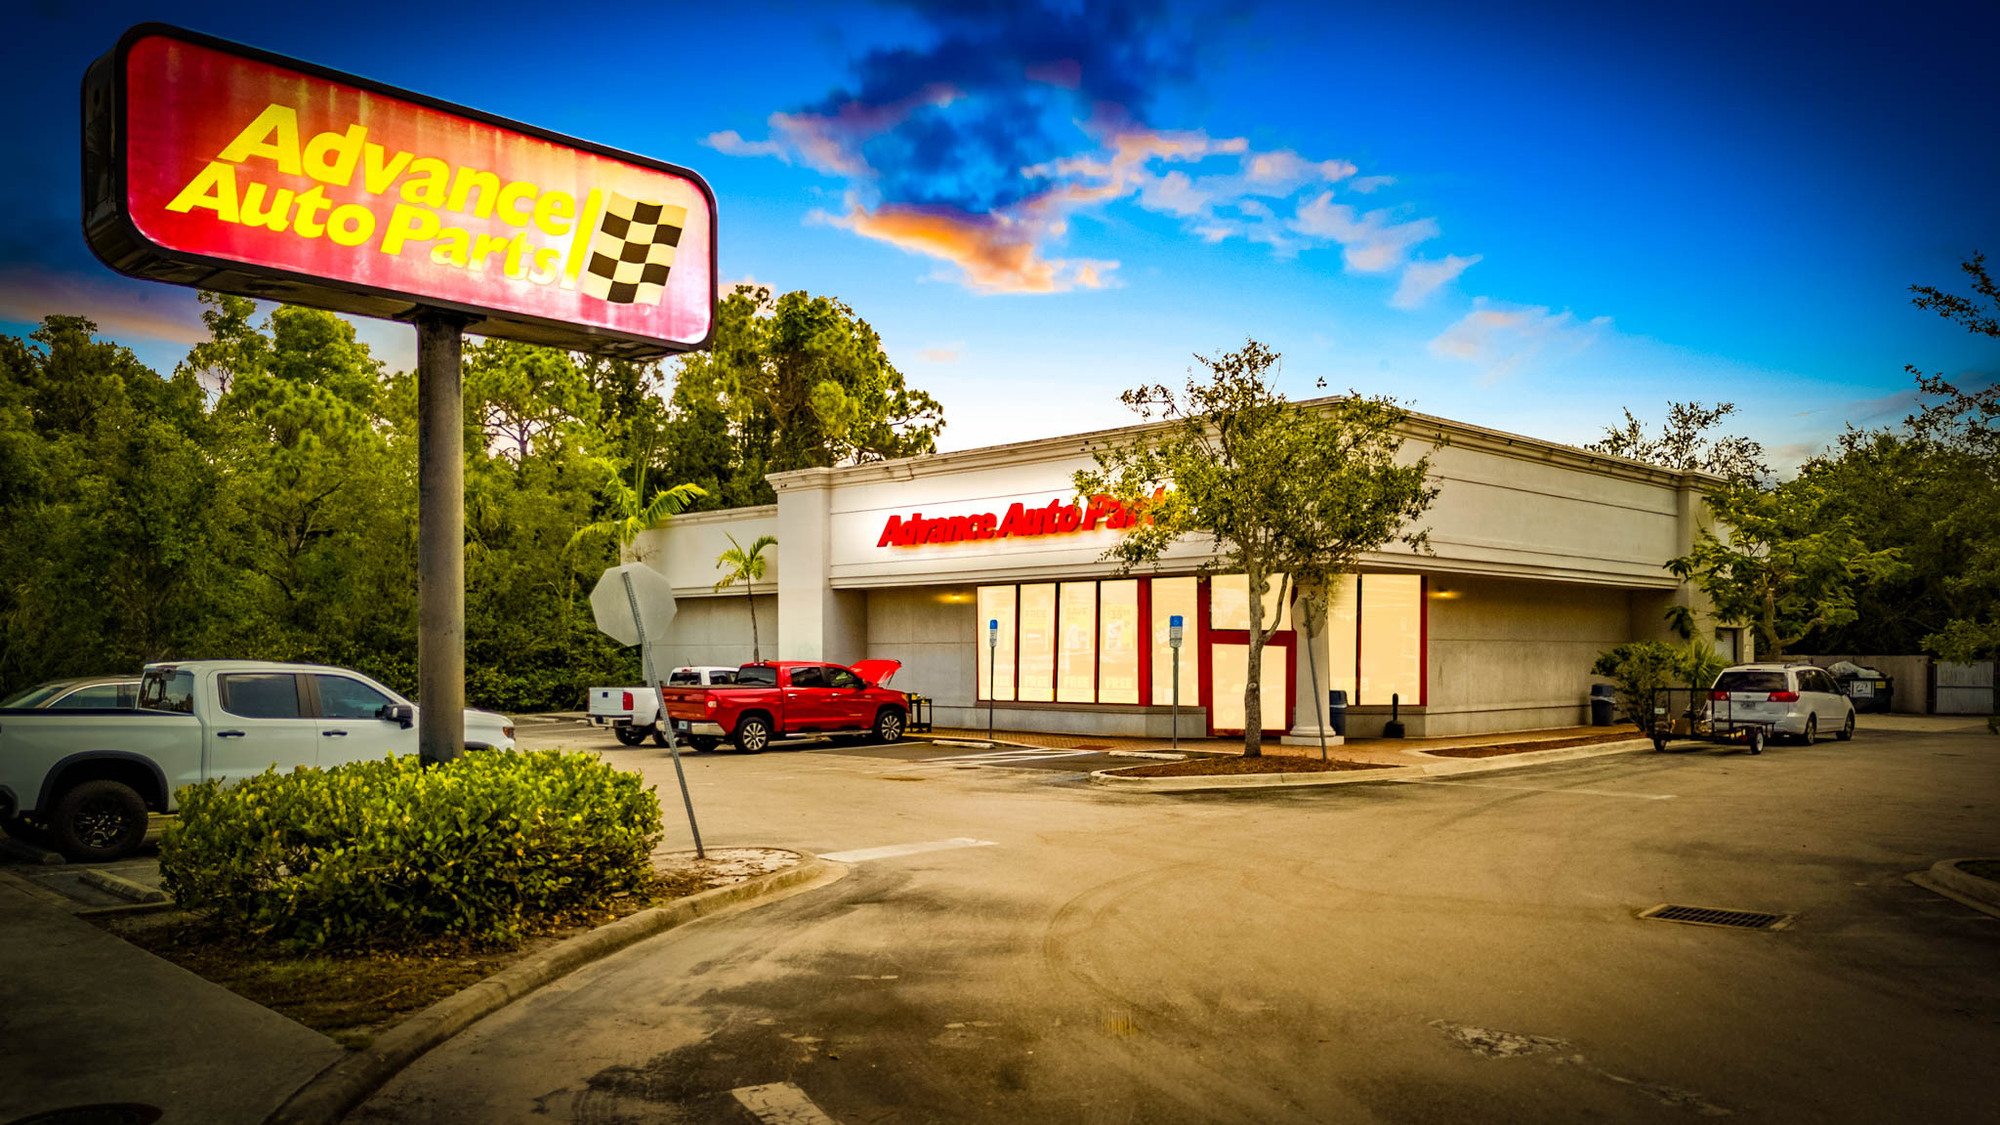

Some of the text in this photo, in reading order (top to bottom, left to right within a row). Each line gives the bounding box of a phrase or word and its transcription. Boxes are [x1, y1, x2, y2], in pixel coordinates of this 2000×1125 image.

[164, 160, 562, 286] Auto Parts
[217, 103, 575, 236] Advance
[877, 513, 998, 547] Advance
[996, 498, 1082, 538] Auto
